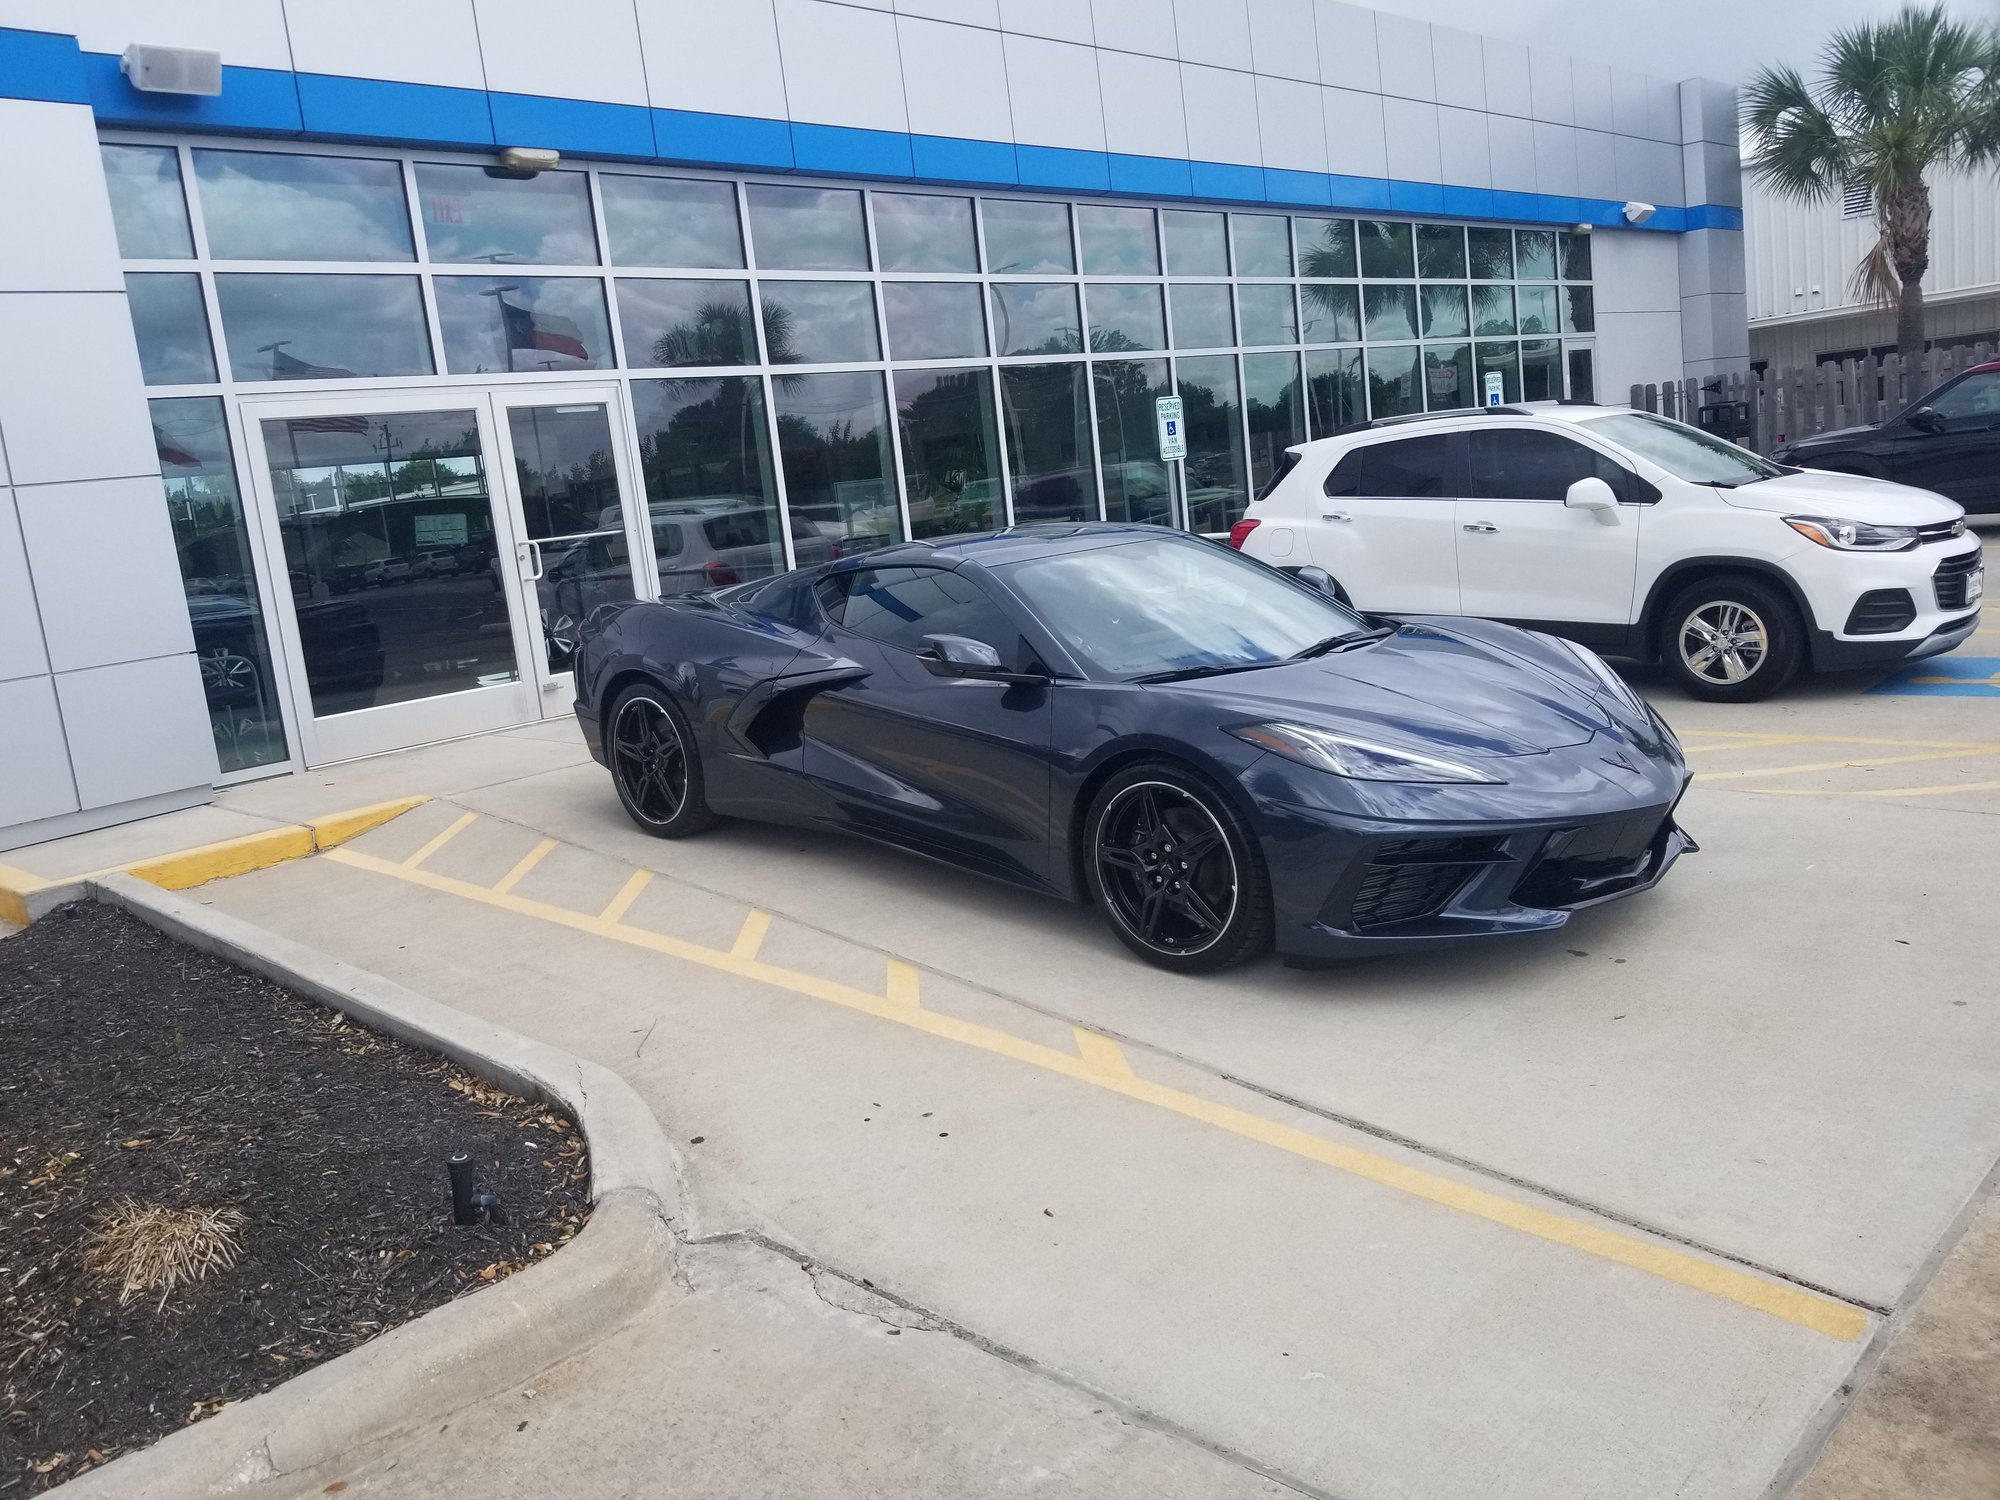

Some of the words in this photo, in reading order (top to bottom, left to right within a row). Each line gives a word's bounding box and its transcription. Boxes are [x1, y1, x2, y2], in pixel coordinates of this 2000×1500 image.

[1158, 401, 1180, 411] RESERVED
[1160, 411, 1180, 420] PARKING
[1163, 444, 1184, 454] ACCESSIBLE
